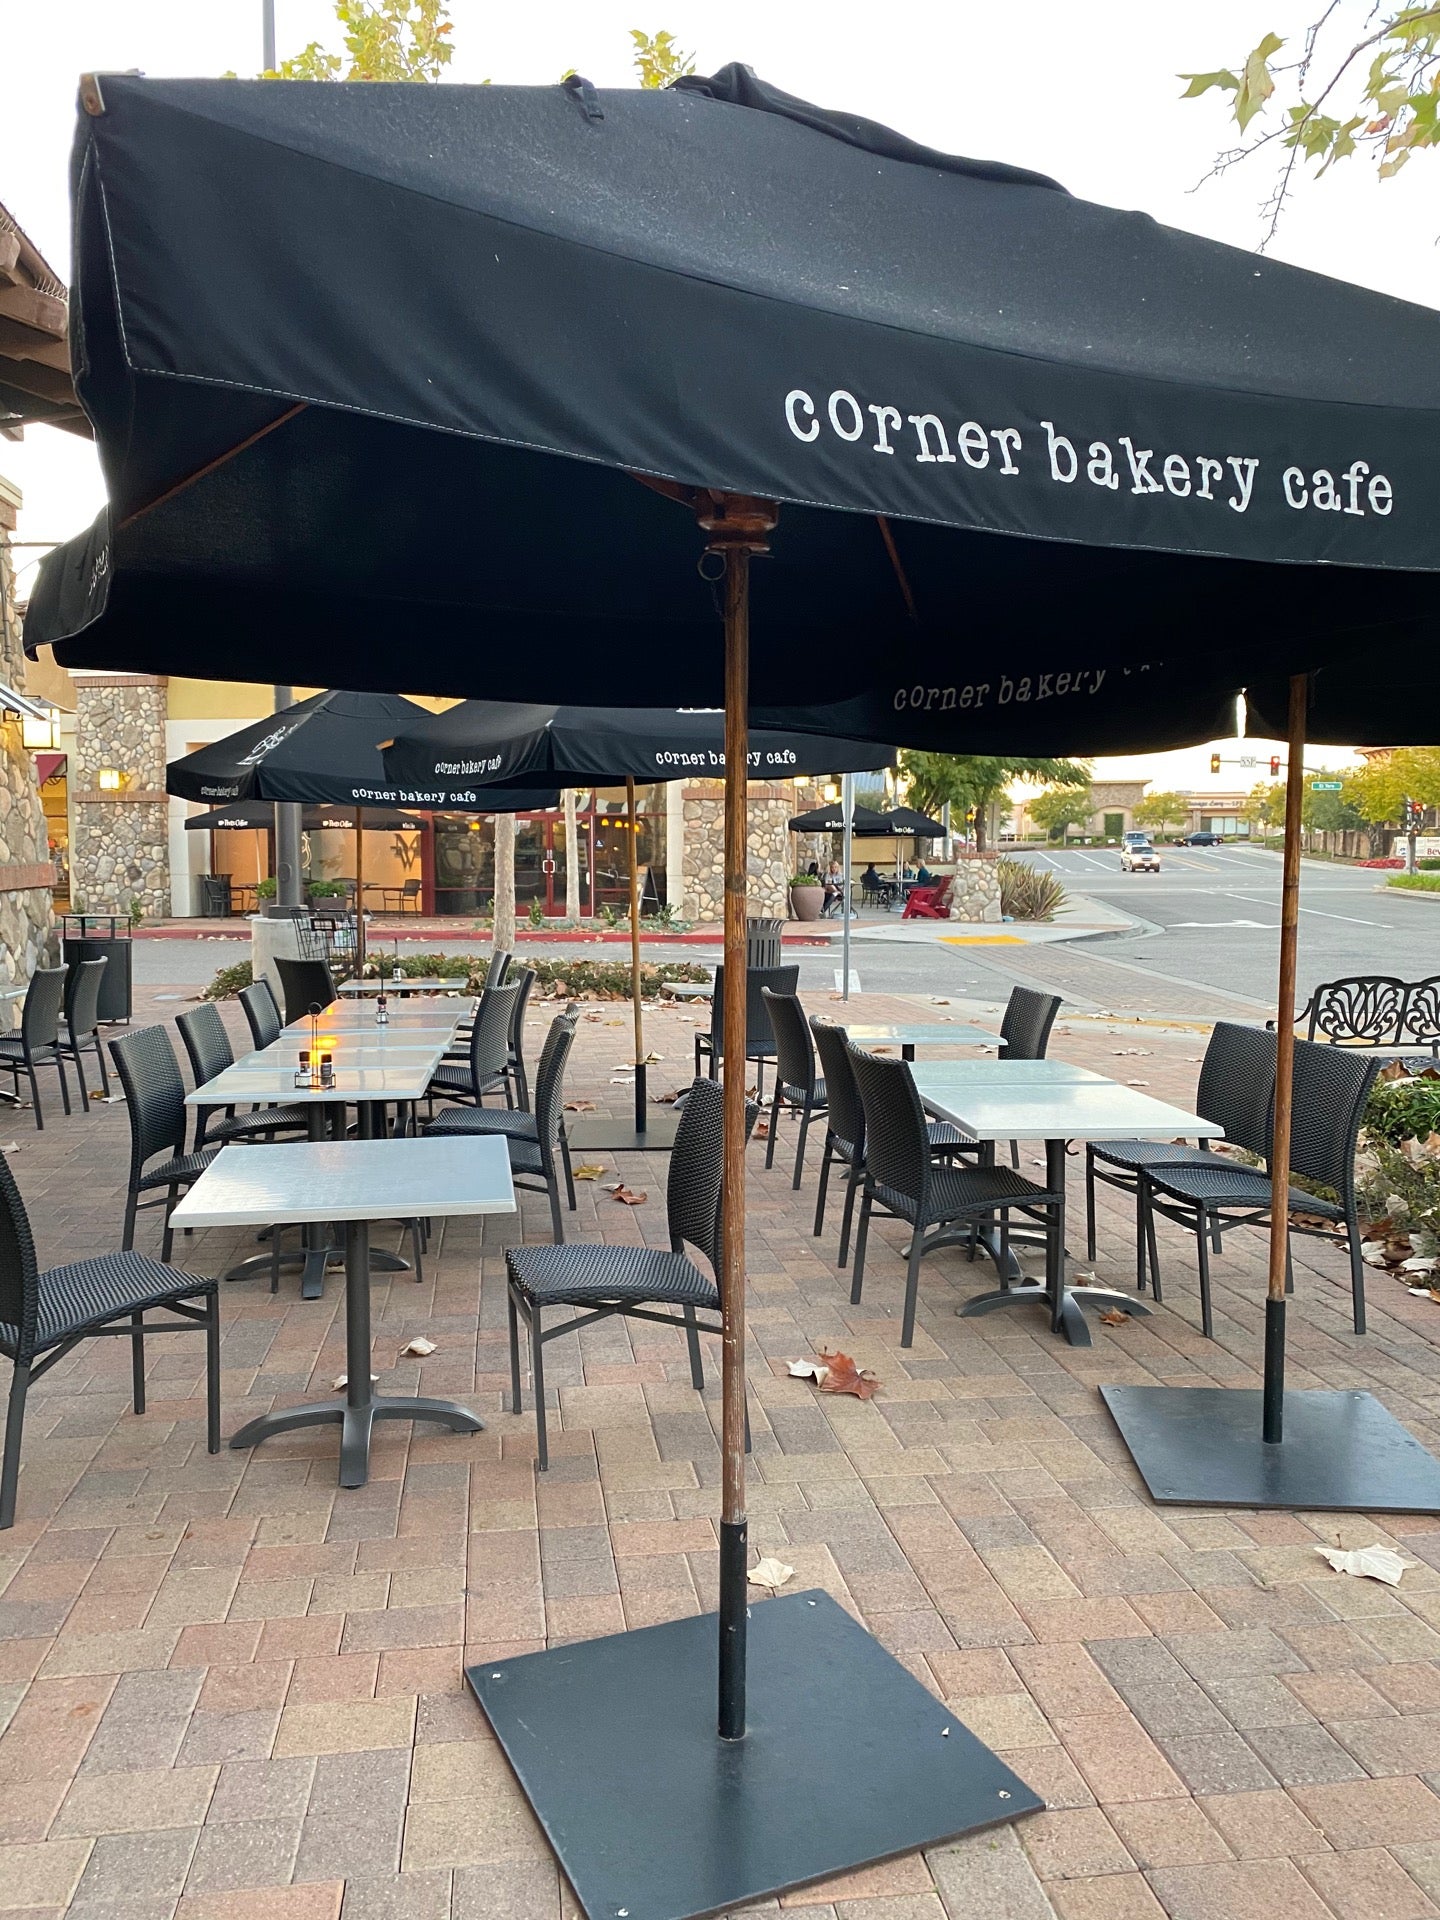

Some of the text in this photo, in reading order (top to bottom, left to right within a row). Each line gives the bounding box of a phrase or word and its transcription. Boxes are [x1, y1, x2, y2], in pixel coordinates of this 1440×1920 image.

[784, 389, 1393, 516] corner bakery cafe
[893, 669, 1106, 711] corner bakery
[434, 760, 461, 775] corner
[461, 758, 487, 775] bakery
[655, 749, 797, 767] corner bary cafe
[351, 788, 477, 804] corner bakery cafe
